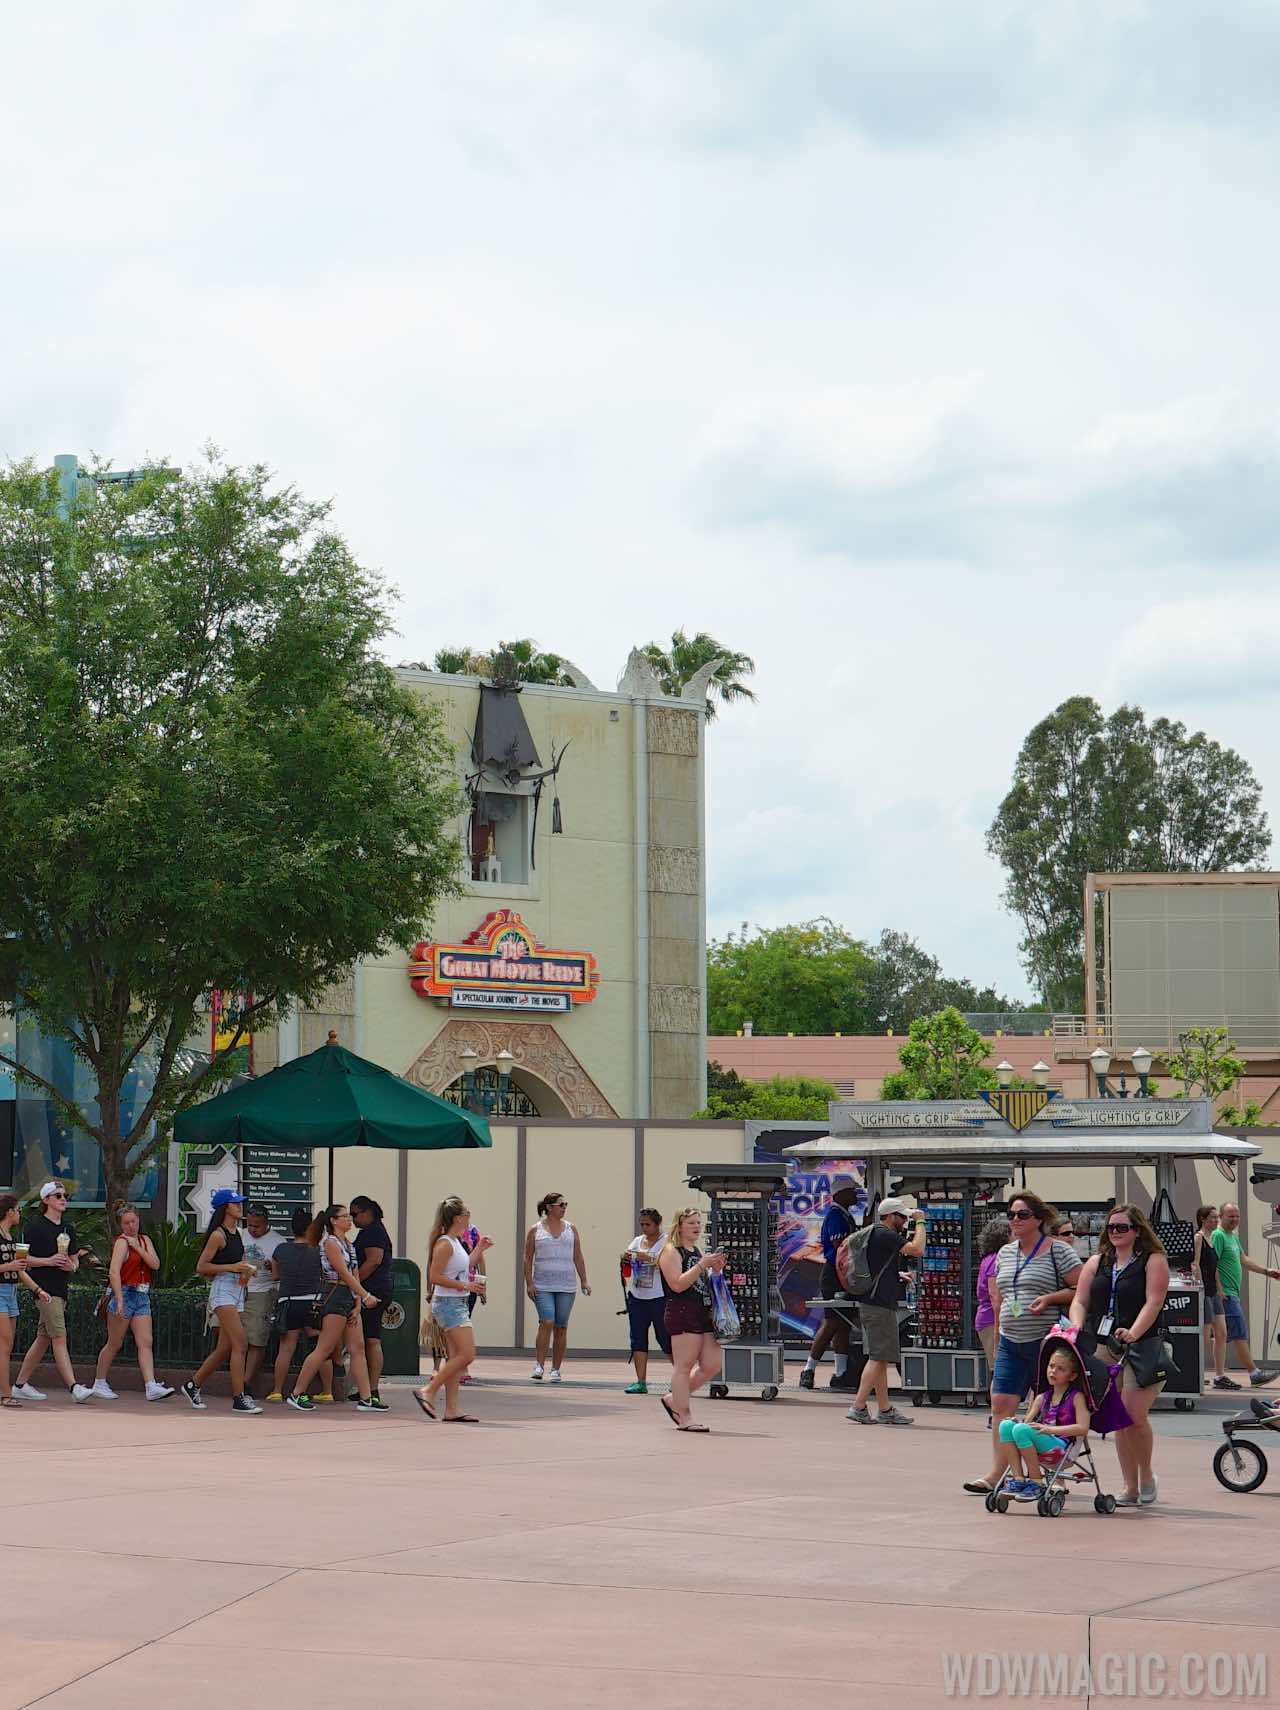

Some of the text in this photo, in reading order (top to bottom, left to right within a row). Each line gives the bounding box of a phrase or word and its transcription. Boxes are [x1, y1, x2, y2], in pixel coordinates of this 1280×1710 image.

[462, 993, 494, 1003] SPECTACULAR
[496, 994, 518, 1004] JOURNEY
[531, 996, 541, 1005] THE
[988, 1091, 1048, 1130] STUDIO
[861, 1113, 910, 1126] LIGHTING
[925, 1113, 949, 1124] GRIP
[1090, 1111, 1140, 1123] LIGHTING
[1155, 1111, 1181, 1122] GRIP
